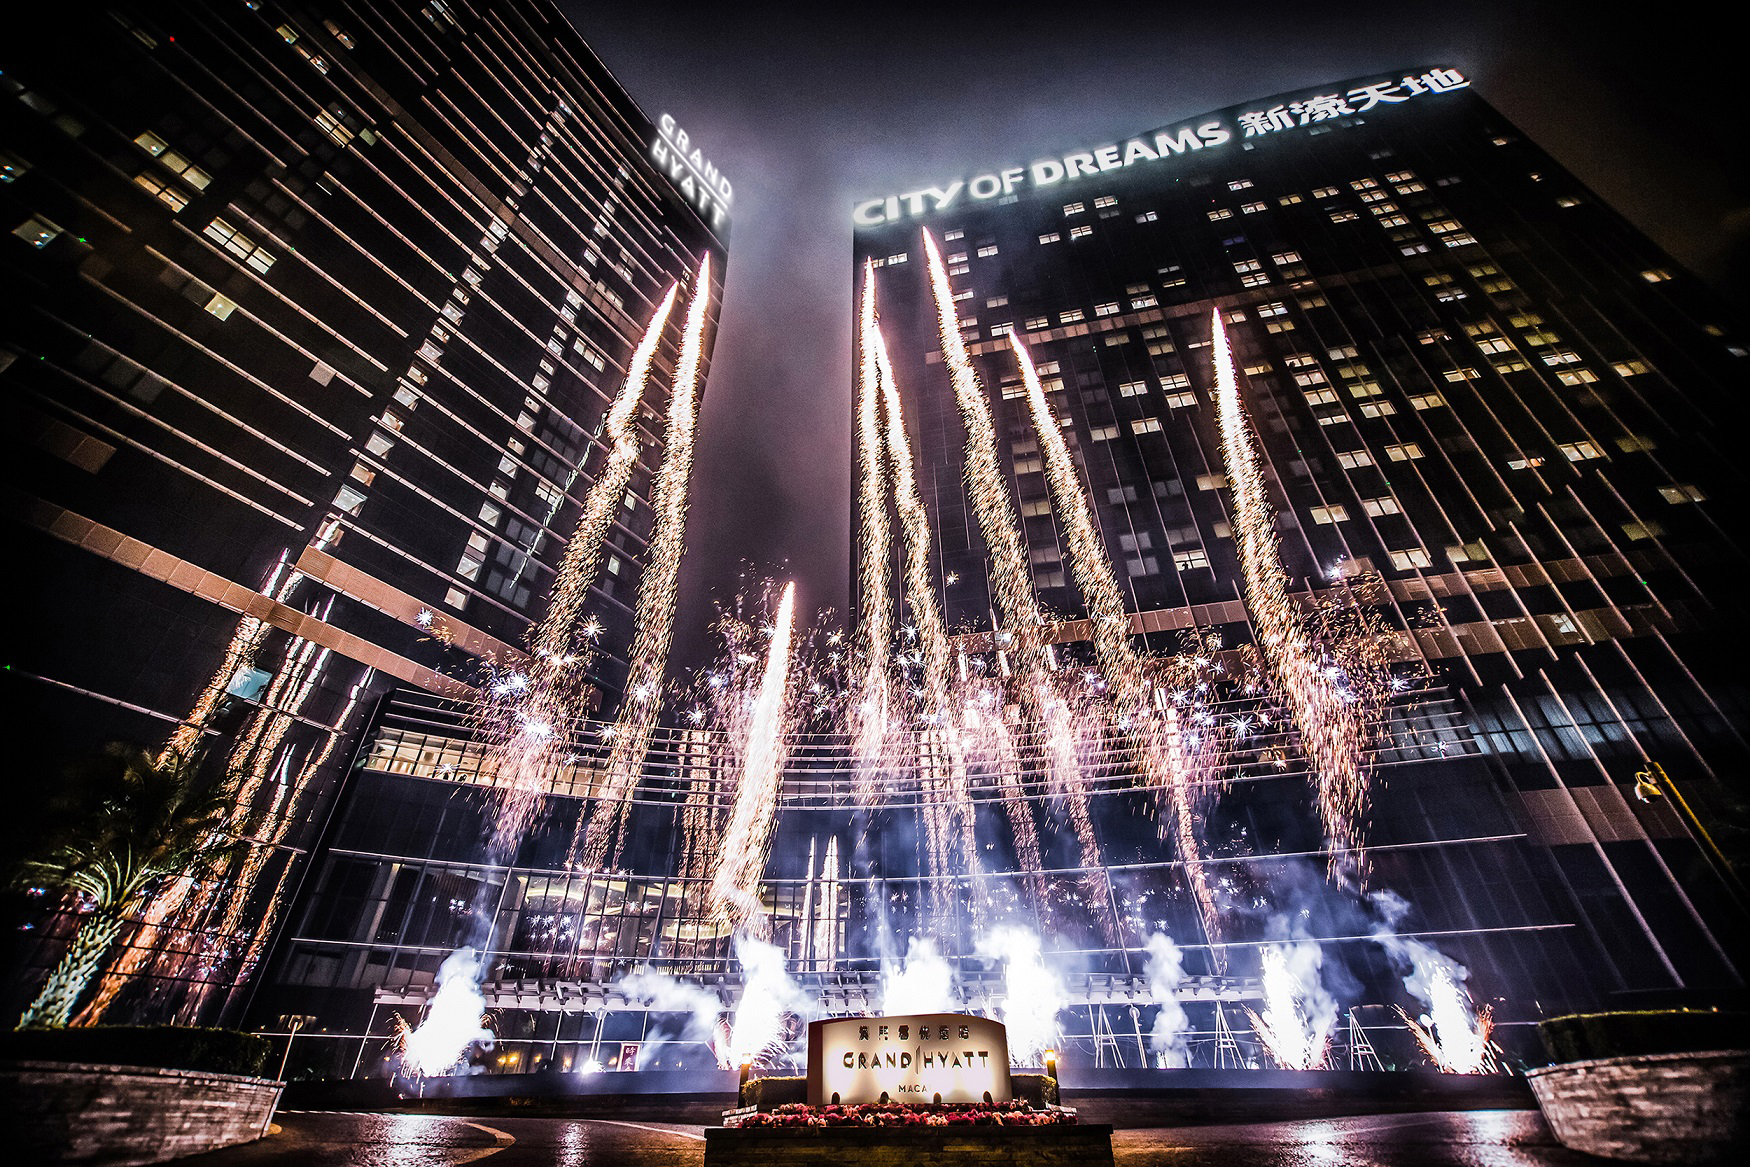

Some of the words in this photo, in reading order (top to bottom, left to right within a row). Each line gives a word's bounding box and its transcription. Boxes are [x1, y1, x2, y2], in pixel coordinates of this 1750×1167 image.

[1237, 68, 1471, 138] 新濠天地
[652, 138, 725, 226] HYATT
[660, 112, 732, 200] GRAND
[853, 181, 963, 225] CITY
[969, 167, 1024, 199] OF
[1031, 121, 1230, 186] DREAMS
[842, 1051, 912, 1070] GRAND
[923, 1050, 989, 1069] HYATT
[898, 1084, 932, 1093] MACA
